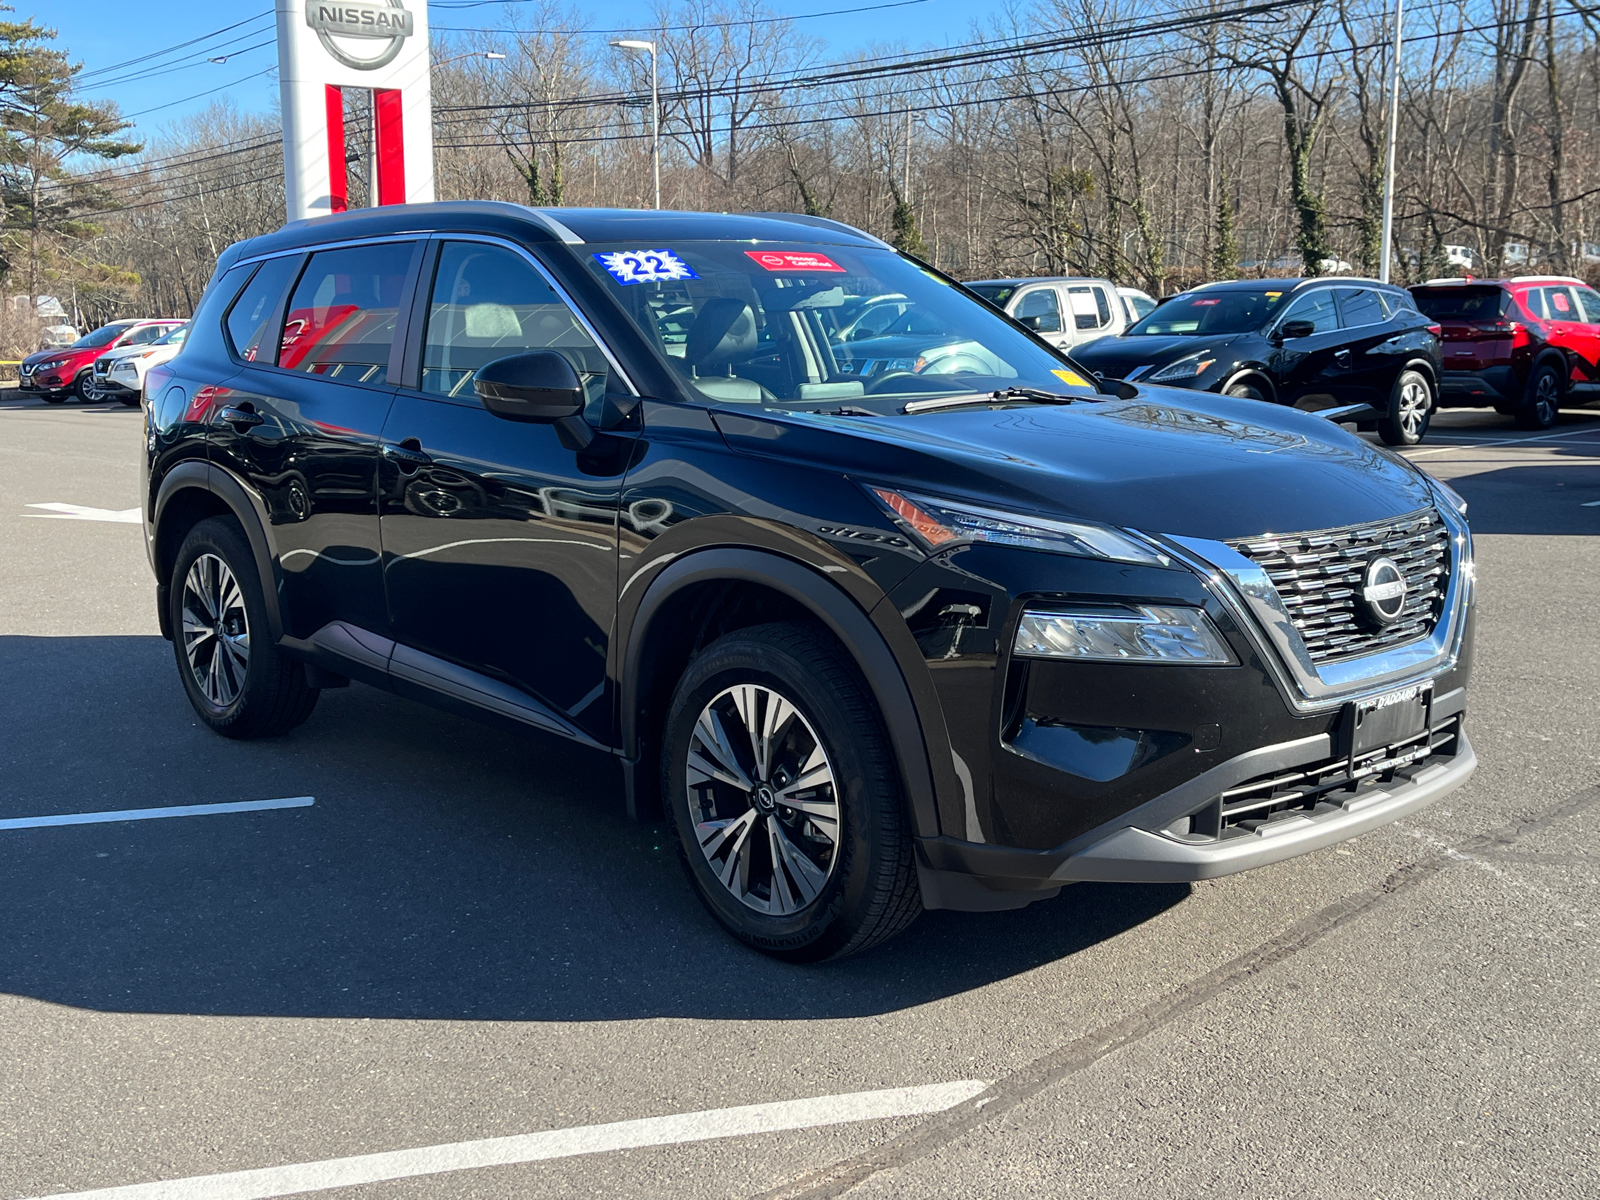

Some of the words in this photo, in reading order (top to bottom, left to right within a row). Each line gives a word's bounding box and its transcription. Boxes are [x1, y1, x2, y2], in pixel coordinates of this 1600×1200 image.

[319, 6, 405, 29] NISSAN
[623, 255, 672, 276] 22
[1365, 582, 1408, 599] NISSAN
[752, 925, 820, 948] DESTINATION
